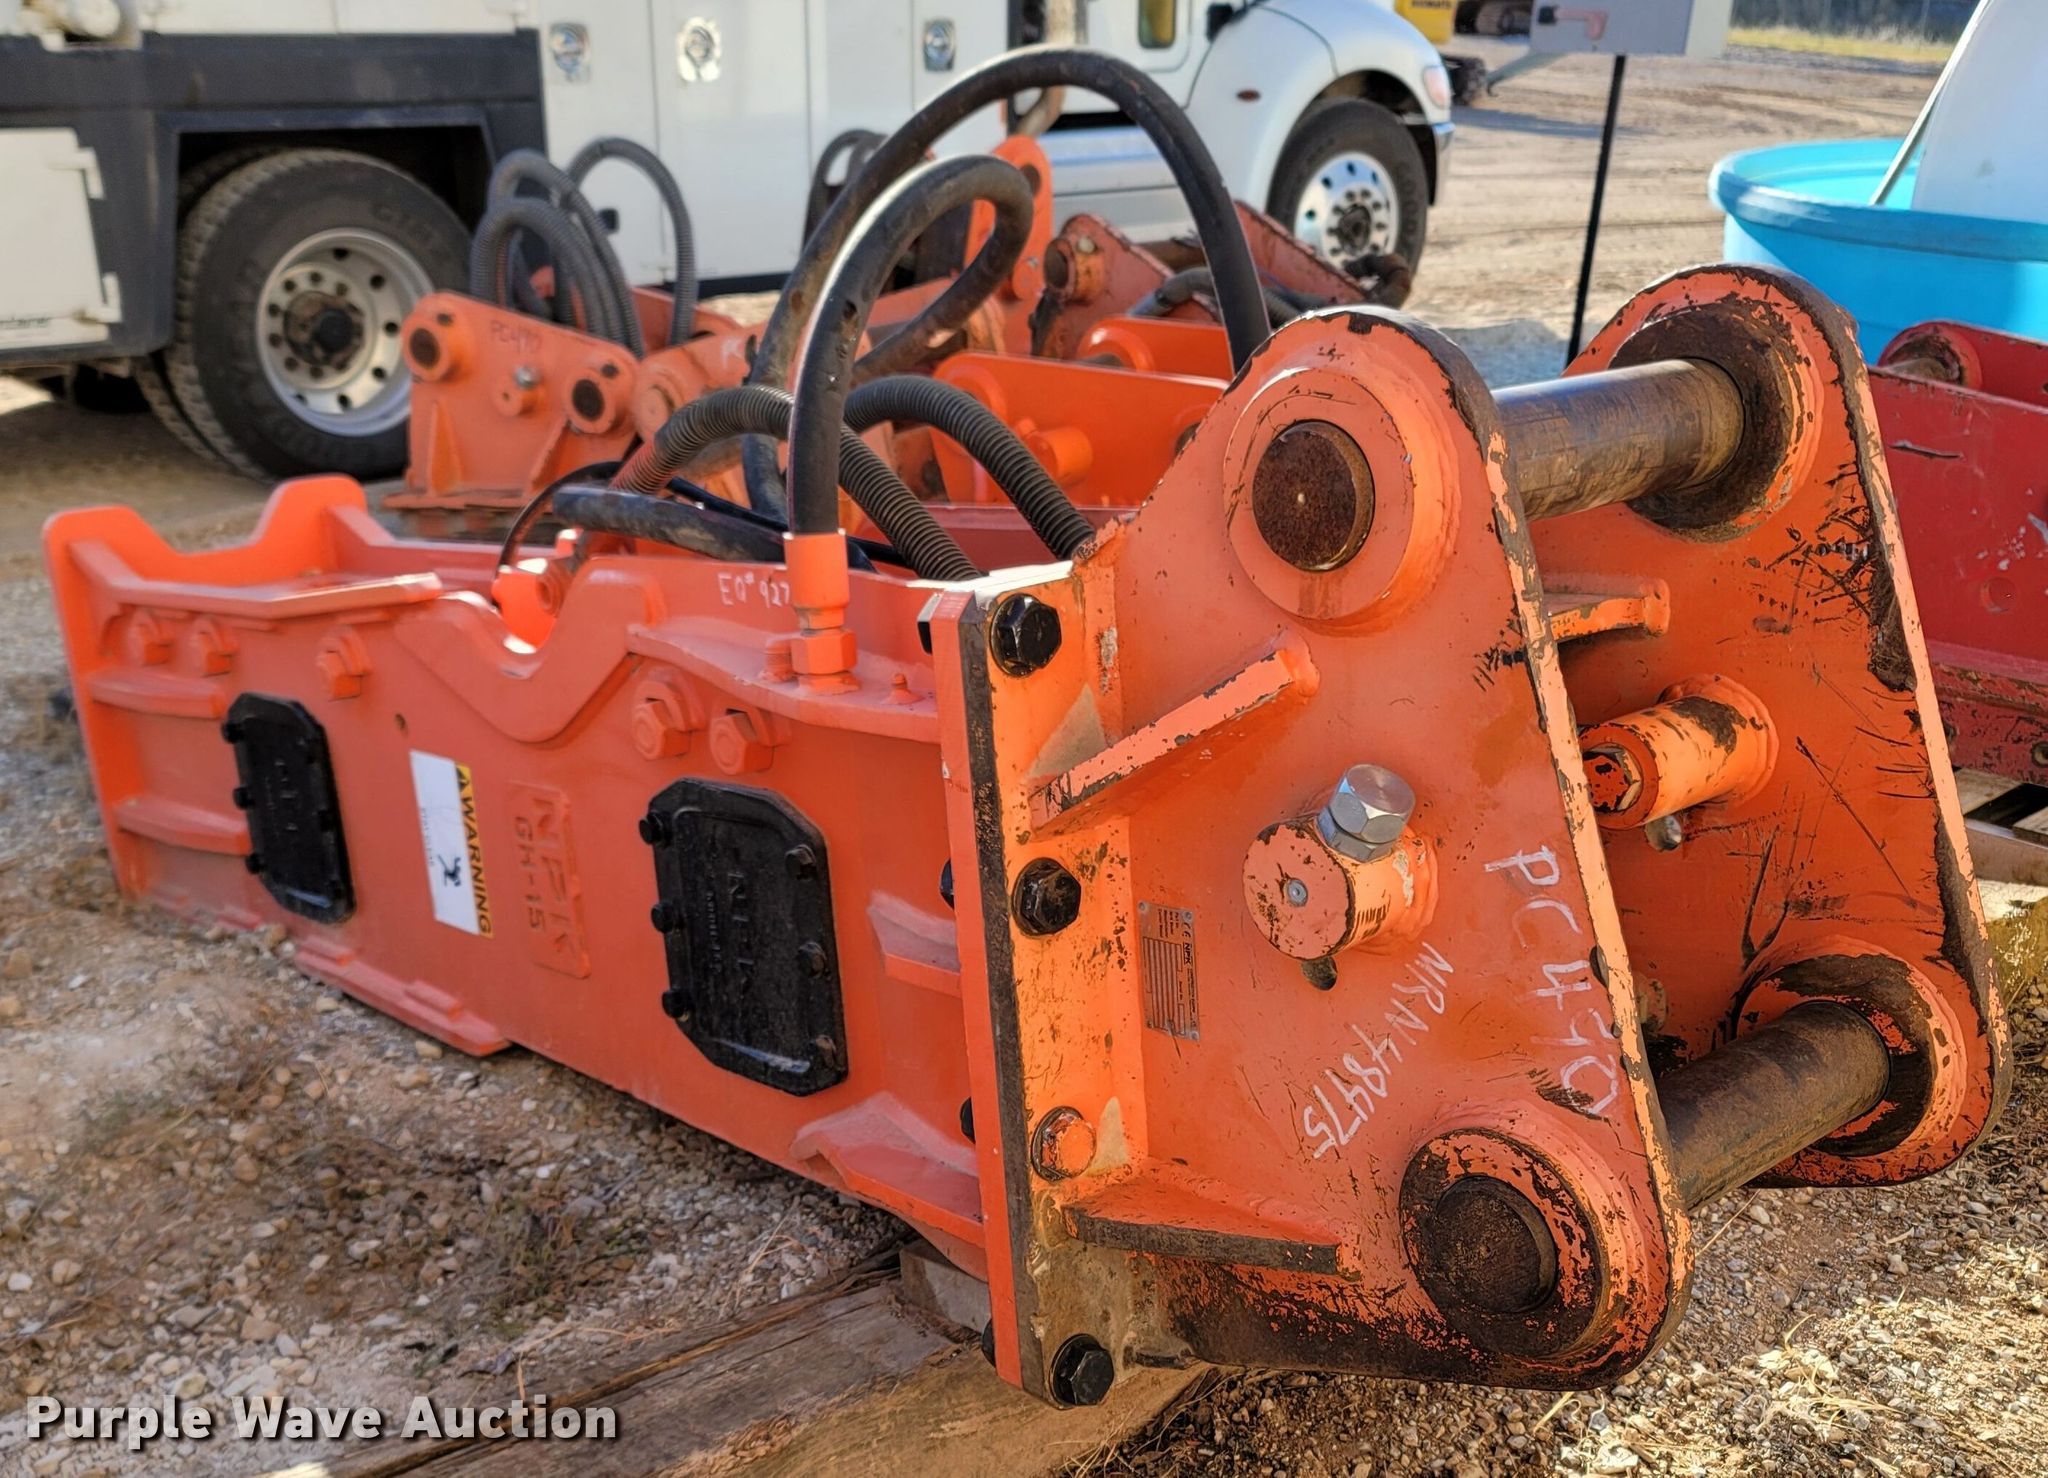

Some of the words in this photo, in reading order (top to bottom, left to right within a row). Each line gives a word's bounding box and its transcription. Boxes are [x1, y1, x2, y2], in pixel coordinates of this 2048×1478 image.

[461, 796, 492, 935] WARNING
[515, 815, 546, 932] GH-15
[1183, 942, 1192, 965] NPK
